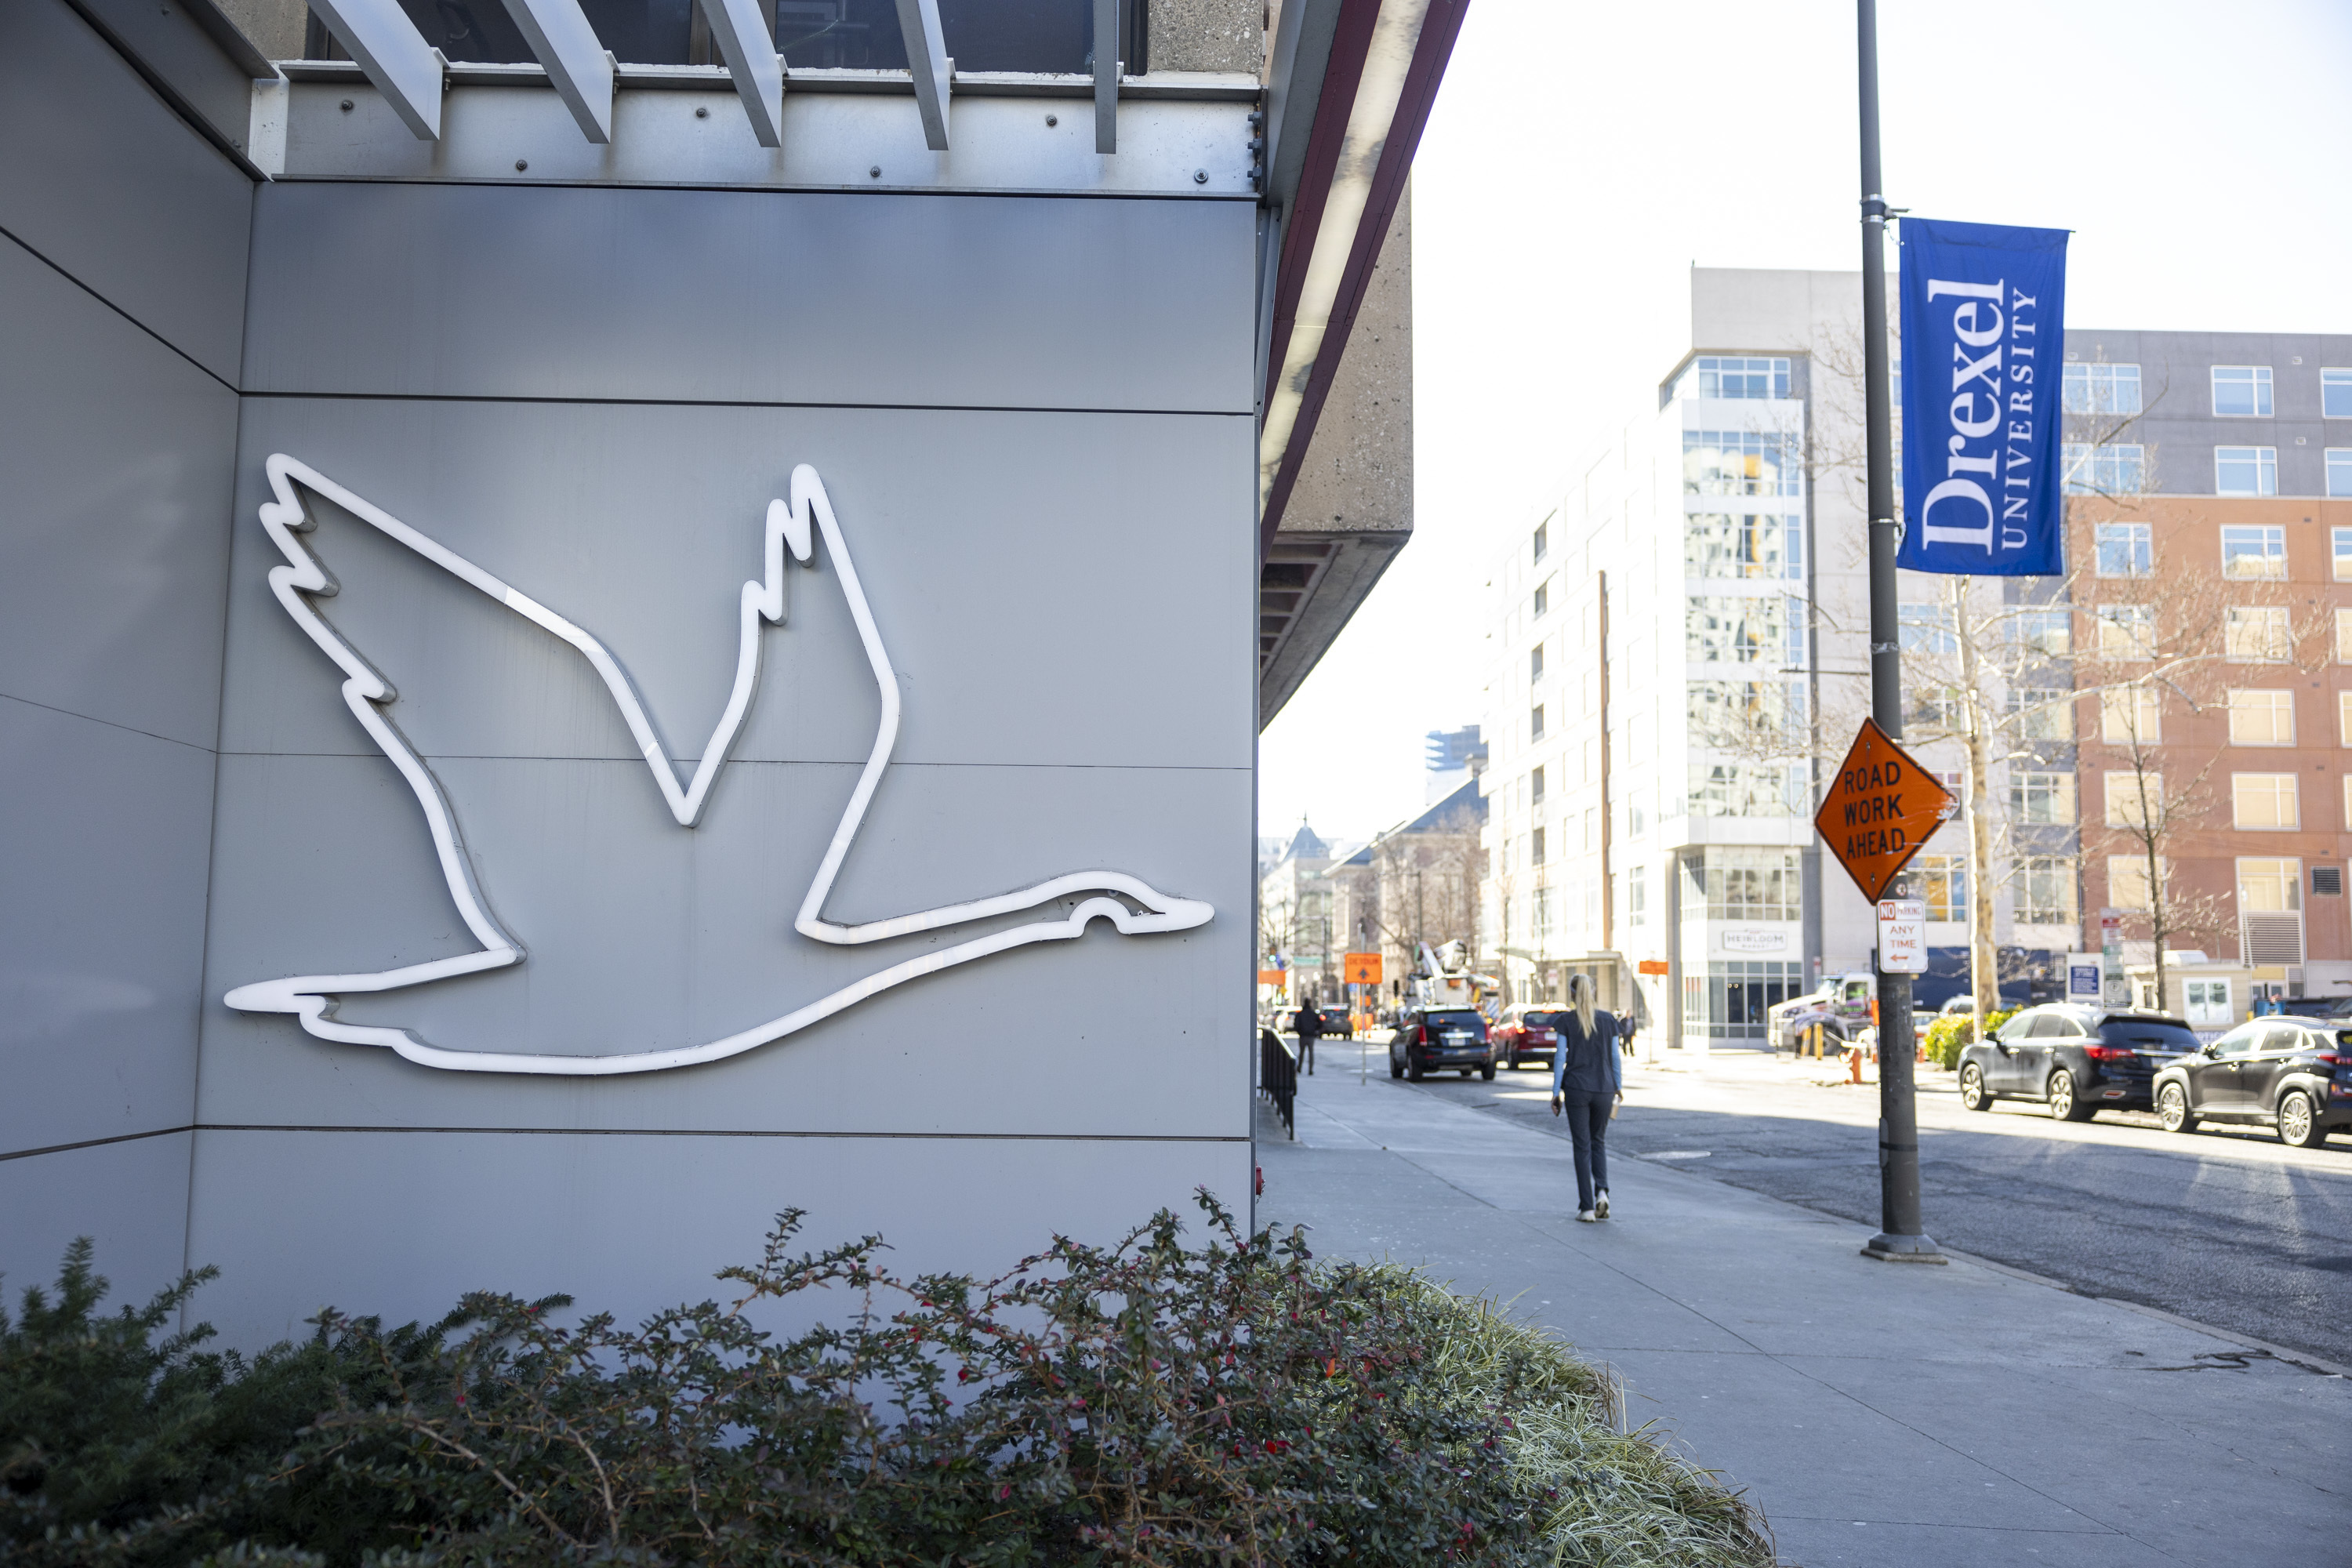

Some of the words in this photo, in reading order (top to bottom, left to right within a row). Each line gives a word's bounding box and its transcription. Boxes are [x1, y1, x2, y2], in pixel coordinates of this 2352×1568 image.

[1922, 278, 2005, 555] Drexel
[2002, 287, 2037, 551] UNIVERSITY
[1844, 760, 1902, 795] ROAD
[1844, 794, 1904, 827] WORK
[1846, 828, 1906, 860] AHEAD
[1880, 903, 1895, 919] NO
[1896, 906, 1922, 916] PARKING
[1726, 935, 1784, 943] HEIRLOOM
[1889, 925, 1915, 935] ANY
[1889, 939, 1917, 949] TIME
